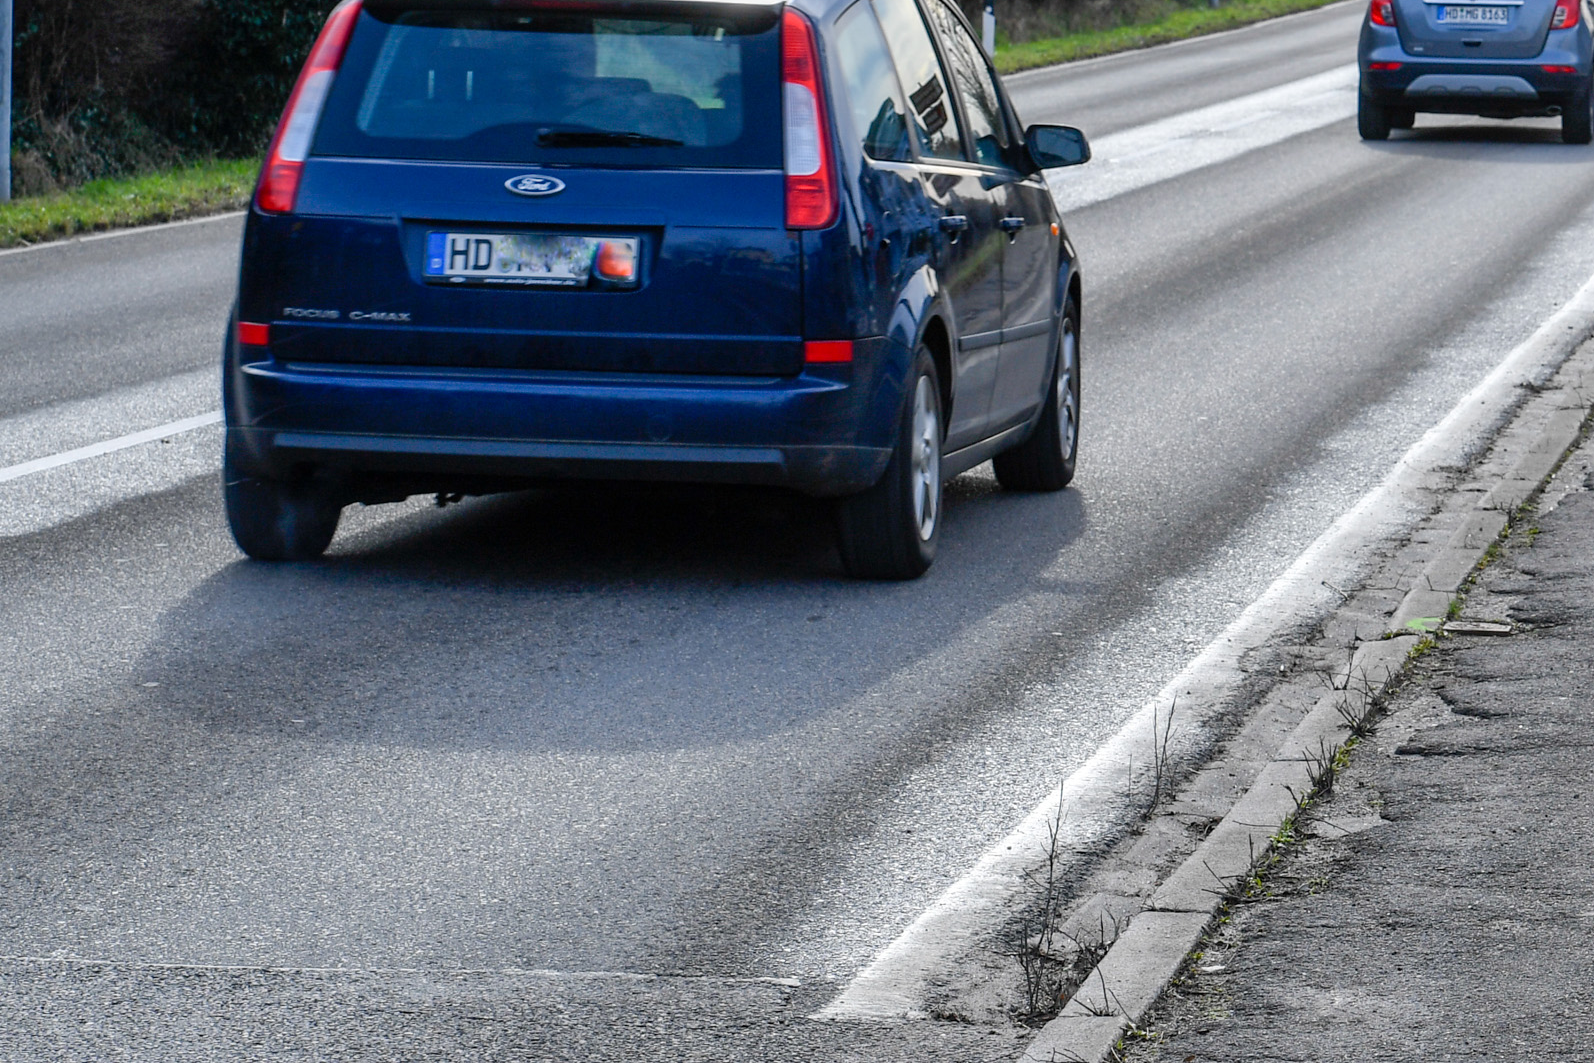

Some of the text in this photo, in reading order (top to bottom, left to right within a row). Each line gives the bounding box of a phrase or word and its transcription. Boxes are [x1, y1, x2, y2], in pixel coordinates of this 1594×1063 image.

[517, 177, 552, 191] Ford
[283, 307, 411, 322] FOCUS C-MAX
